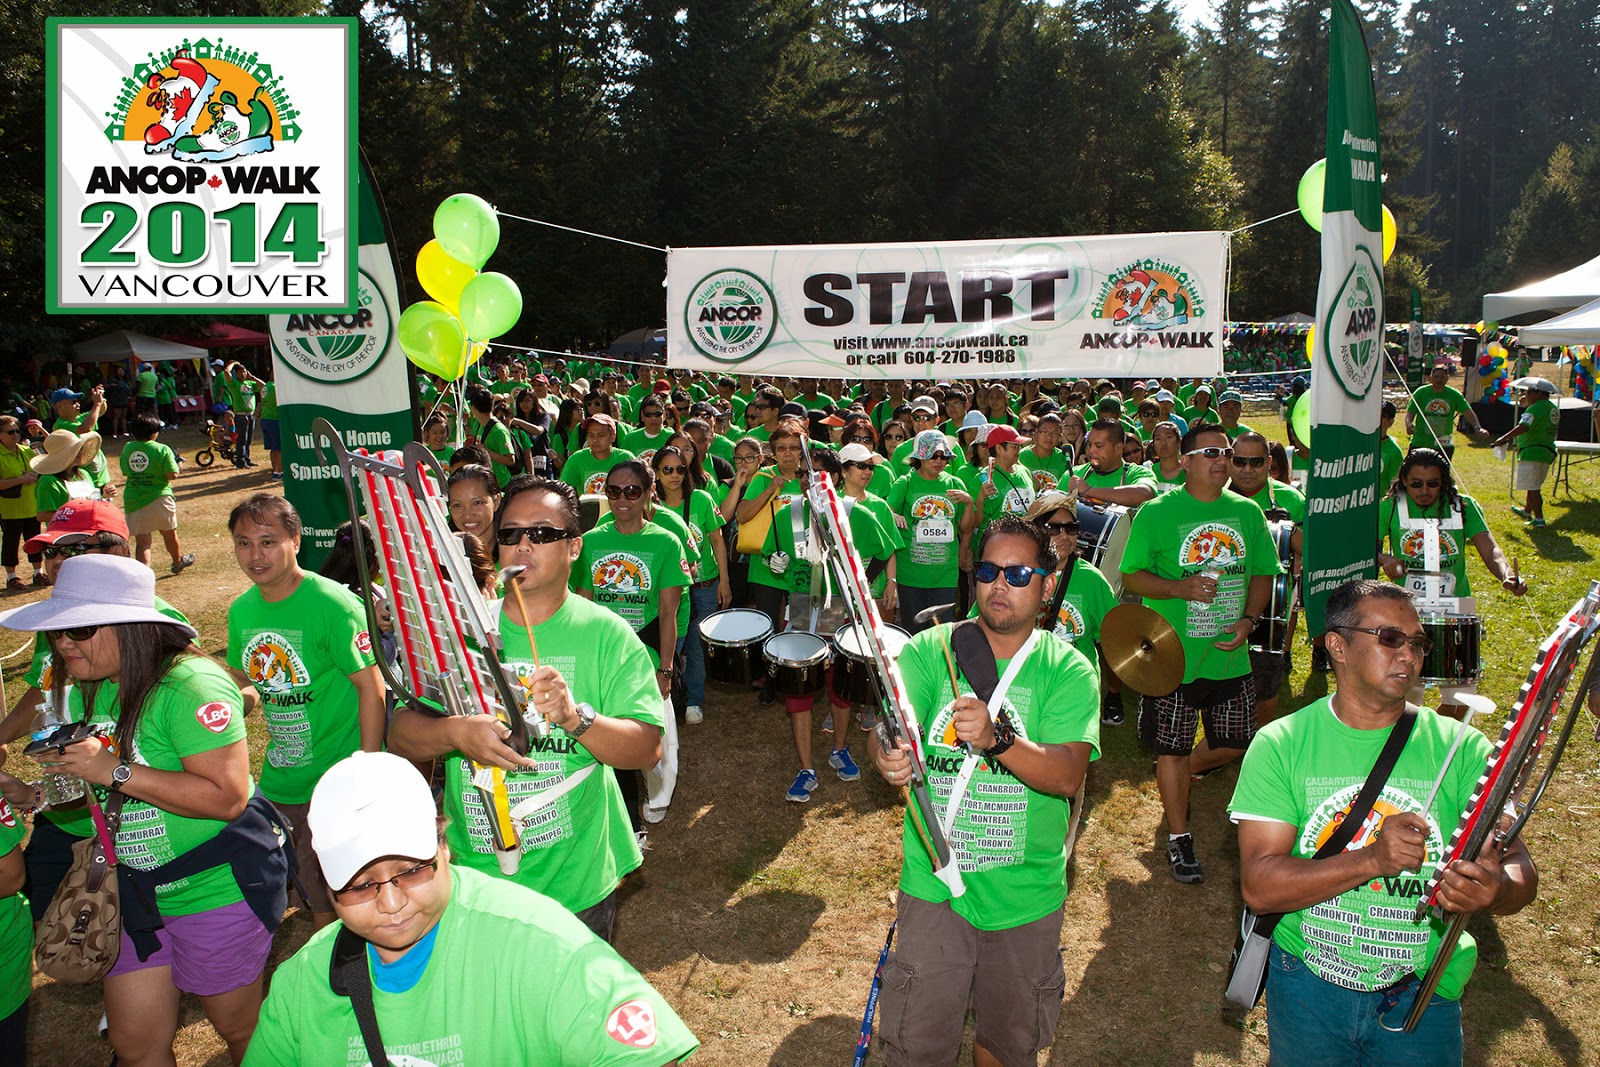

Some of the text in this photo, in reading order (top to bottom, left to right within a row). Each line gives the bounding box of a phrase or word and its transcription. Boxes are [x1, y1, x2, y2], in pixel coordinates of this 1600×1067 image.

[803, 269, 1069, 327] START
[698, 306, 762, 322] ANCOP
[308, 329, 353, 337] CANADA
[1080, 332, 1214, 350] ANCOP WALK
[834, 333, 1029, 350] visit www.ancopwalk.ca
[846, 350, 1016, 366] or call 604-270-1988
[320, 364, 332, 373] THE
[332, 364, 346, 373] CRY
[346, 430, 391, 446] Home
[1308, 494, 1350, 516] ponsor
[923, 528, 948, 536] 0584
[276, 690, 314, 707] WALK
[202, 708, 230, 724] LBC
[528, 738, 578, 754] WALK
[926, 754, 978, 773] ANCO
[506, 774, 565, 792] ORT MCMURRAY
[977, 784, 1024, 793] CRANBROOK
[964, 800, 1027, 811] FORT MCMURRAY
[120, 808, 158, 822] ANBROOK
[526, 810, 557, 827] ORONTO
[970, 814, 1010, 824] MONTREAL
[118, 826, 166, 842] MCMURRAY
[525, 828, 562, 846] WINNIPEG
[986, 828, 1014, 836] REGINA
[116, 844, 148, 855] ONTREAL
[976, 839, 1012, 848] TORONTO
[126, 855, 157, 866] REGINA
[1310, 906, 1360, 924] EDMONTON
[1352, 924, 1376, 939] FORT
[1362, 944, 1412, 960] MONTREAL
[1304, 950, 1358, 979] VANCOUVER
[1320, 970, 1367, 990] VICTORIA
